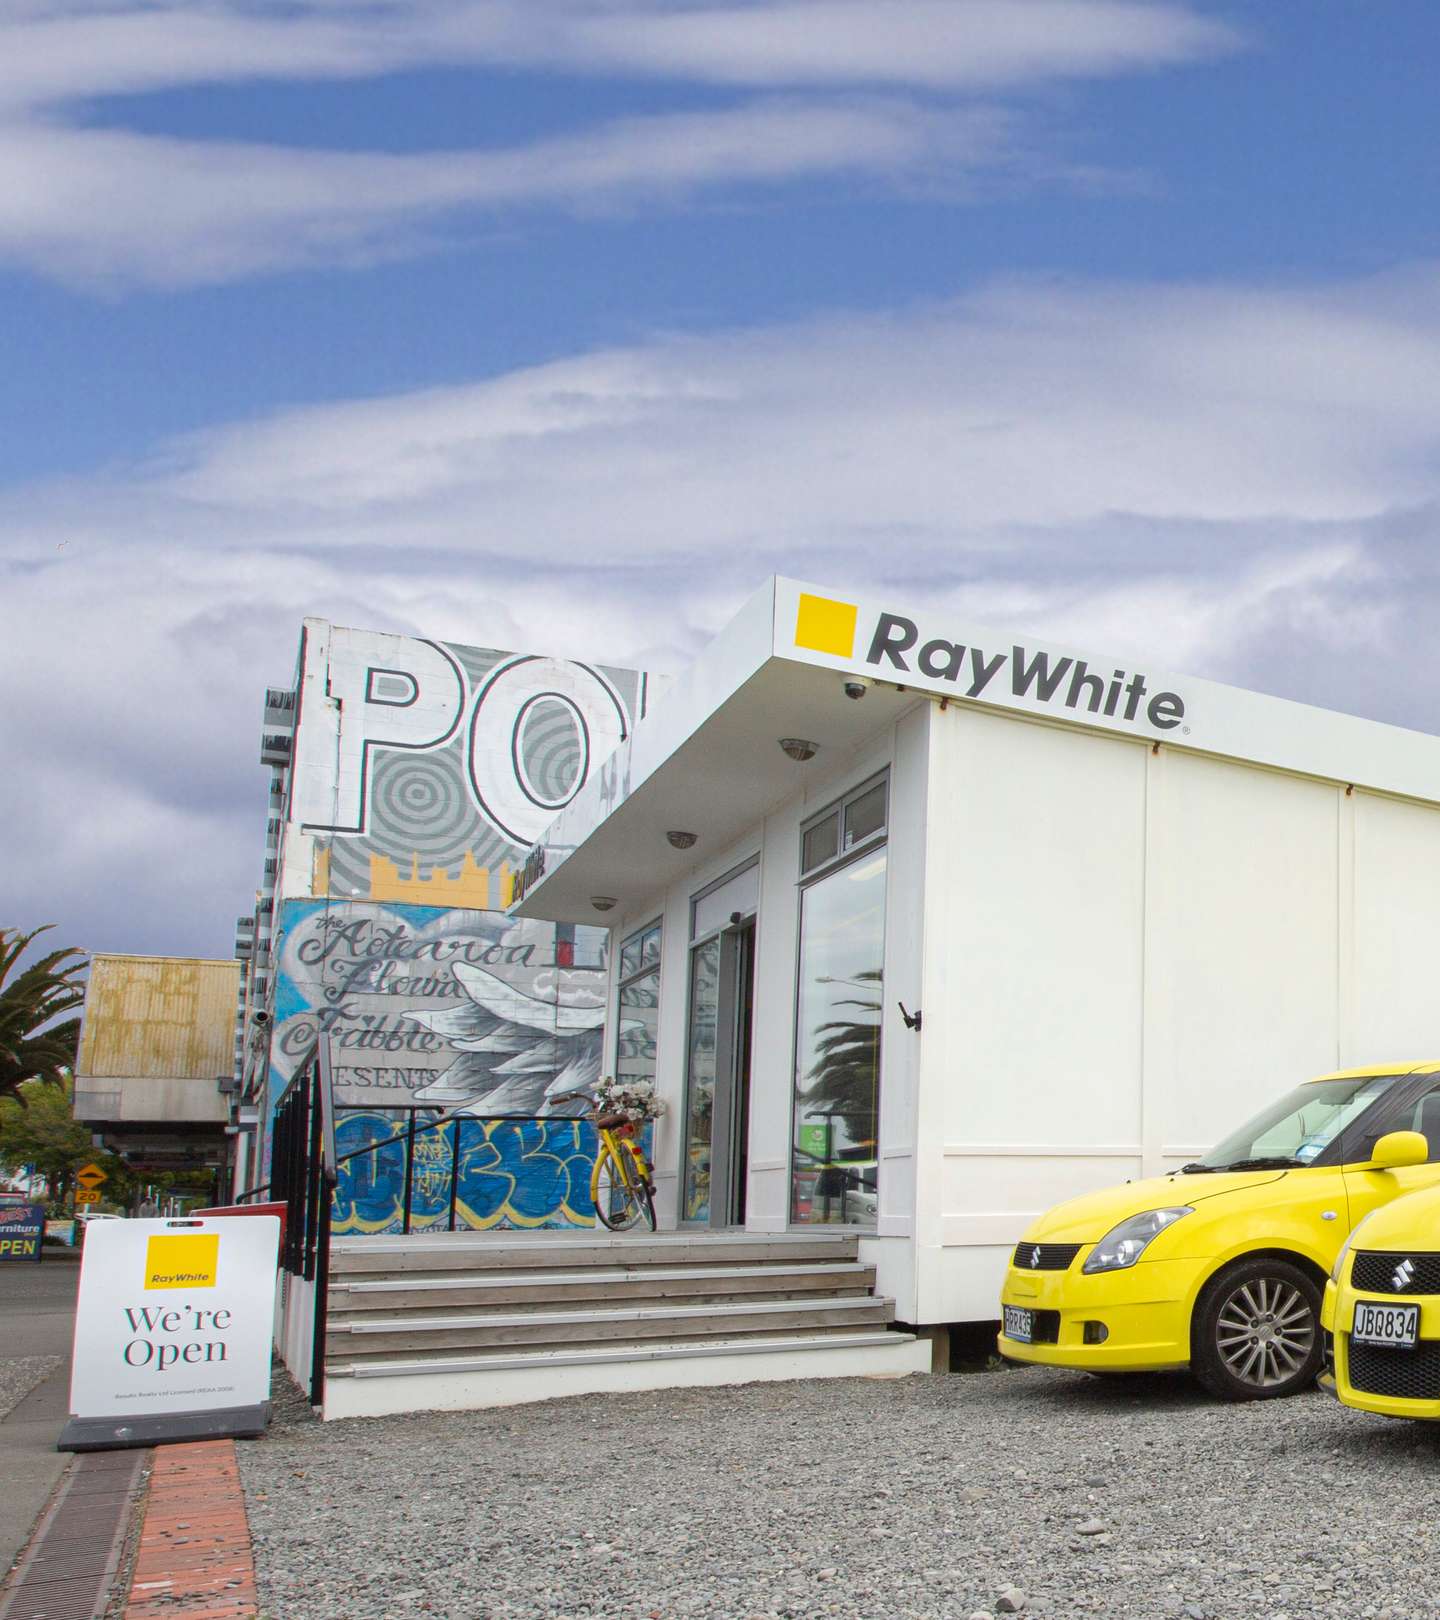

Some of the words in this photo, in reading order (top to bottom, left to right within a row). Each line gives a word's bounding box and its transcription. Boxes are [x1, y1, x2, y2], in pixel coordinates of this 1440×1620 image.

[866, 612, 1185, 730] RayWhite
[288, 624, 648, 848] PO
[298, 919, 543, 967] Aotearoa
[332, 1066, 440, 1090] ESENTS
[1355, 1309, 1416, 1340] JBQ834
[124, 1338, 228, 1371] Open
